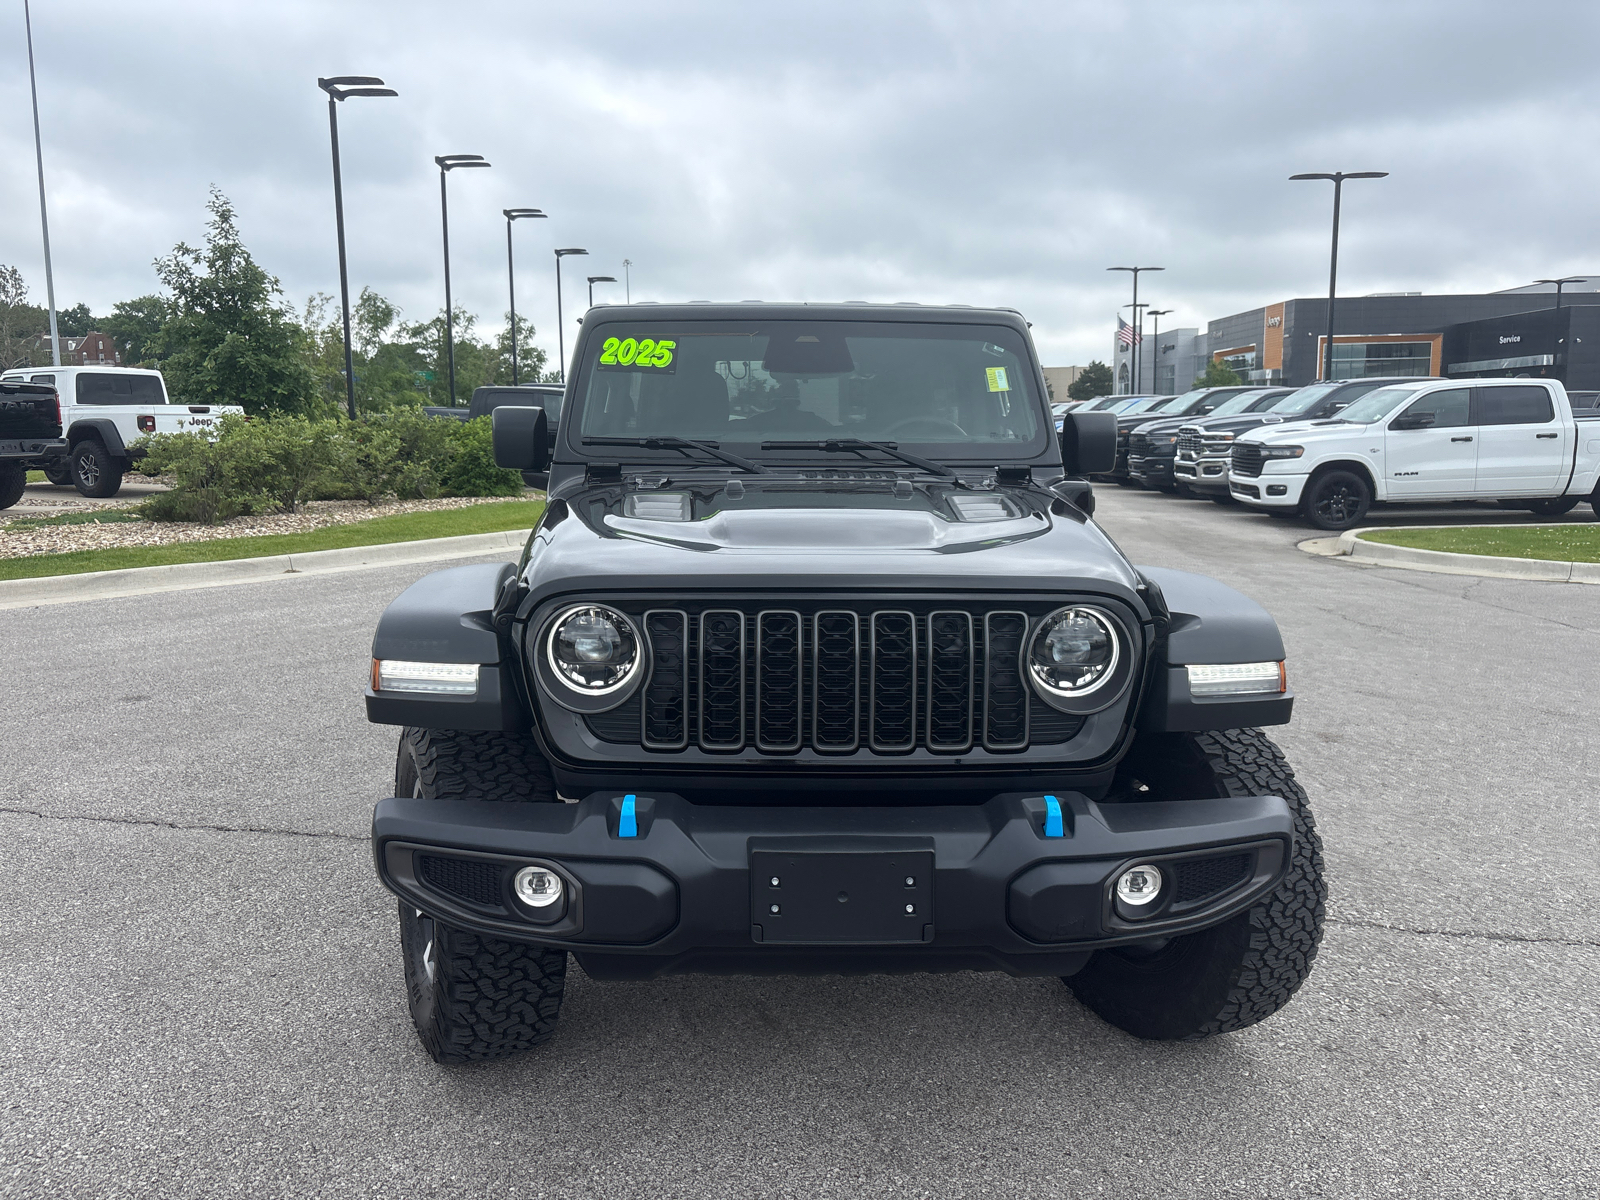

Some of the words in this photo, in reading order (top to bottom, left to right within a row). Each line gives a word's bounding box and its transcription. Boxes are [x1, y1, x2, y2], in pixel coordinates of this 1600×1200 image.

[1499, 335, 1520, 344] Service
[600, 337, 676, 368] 2025
[189, 416, 213, 427] Jeep
